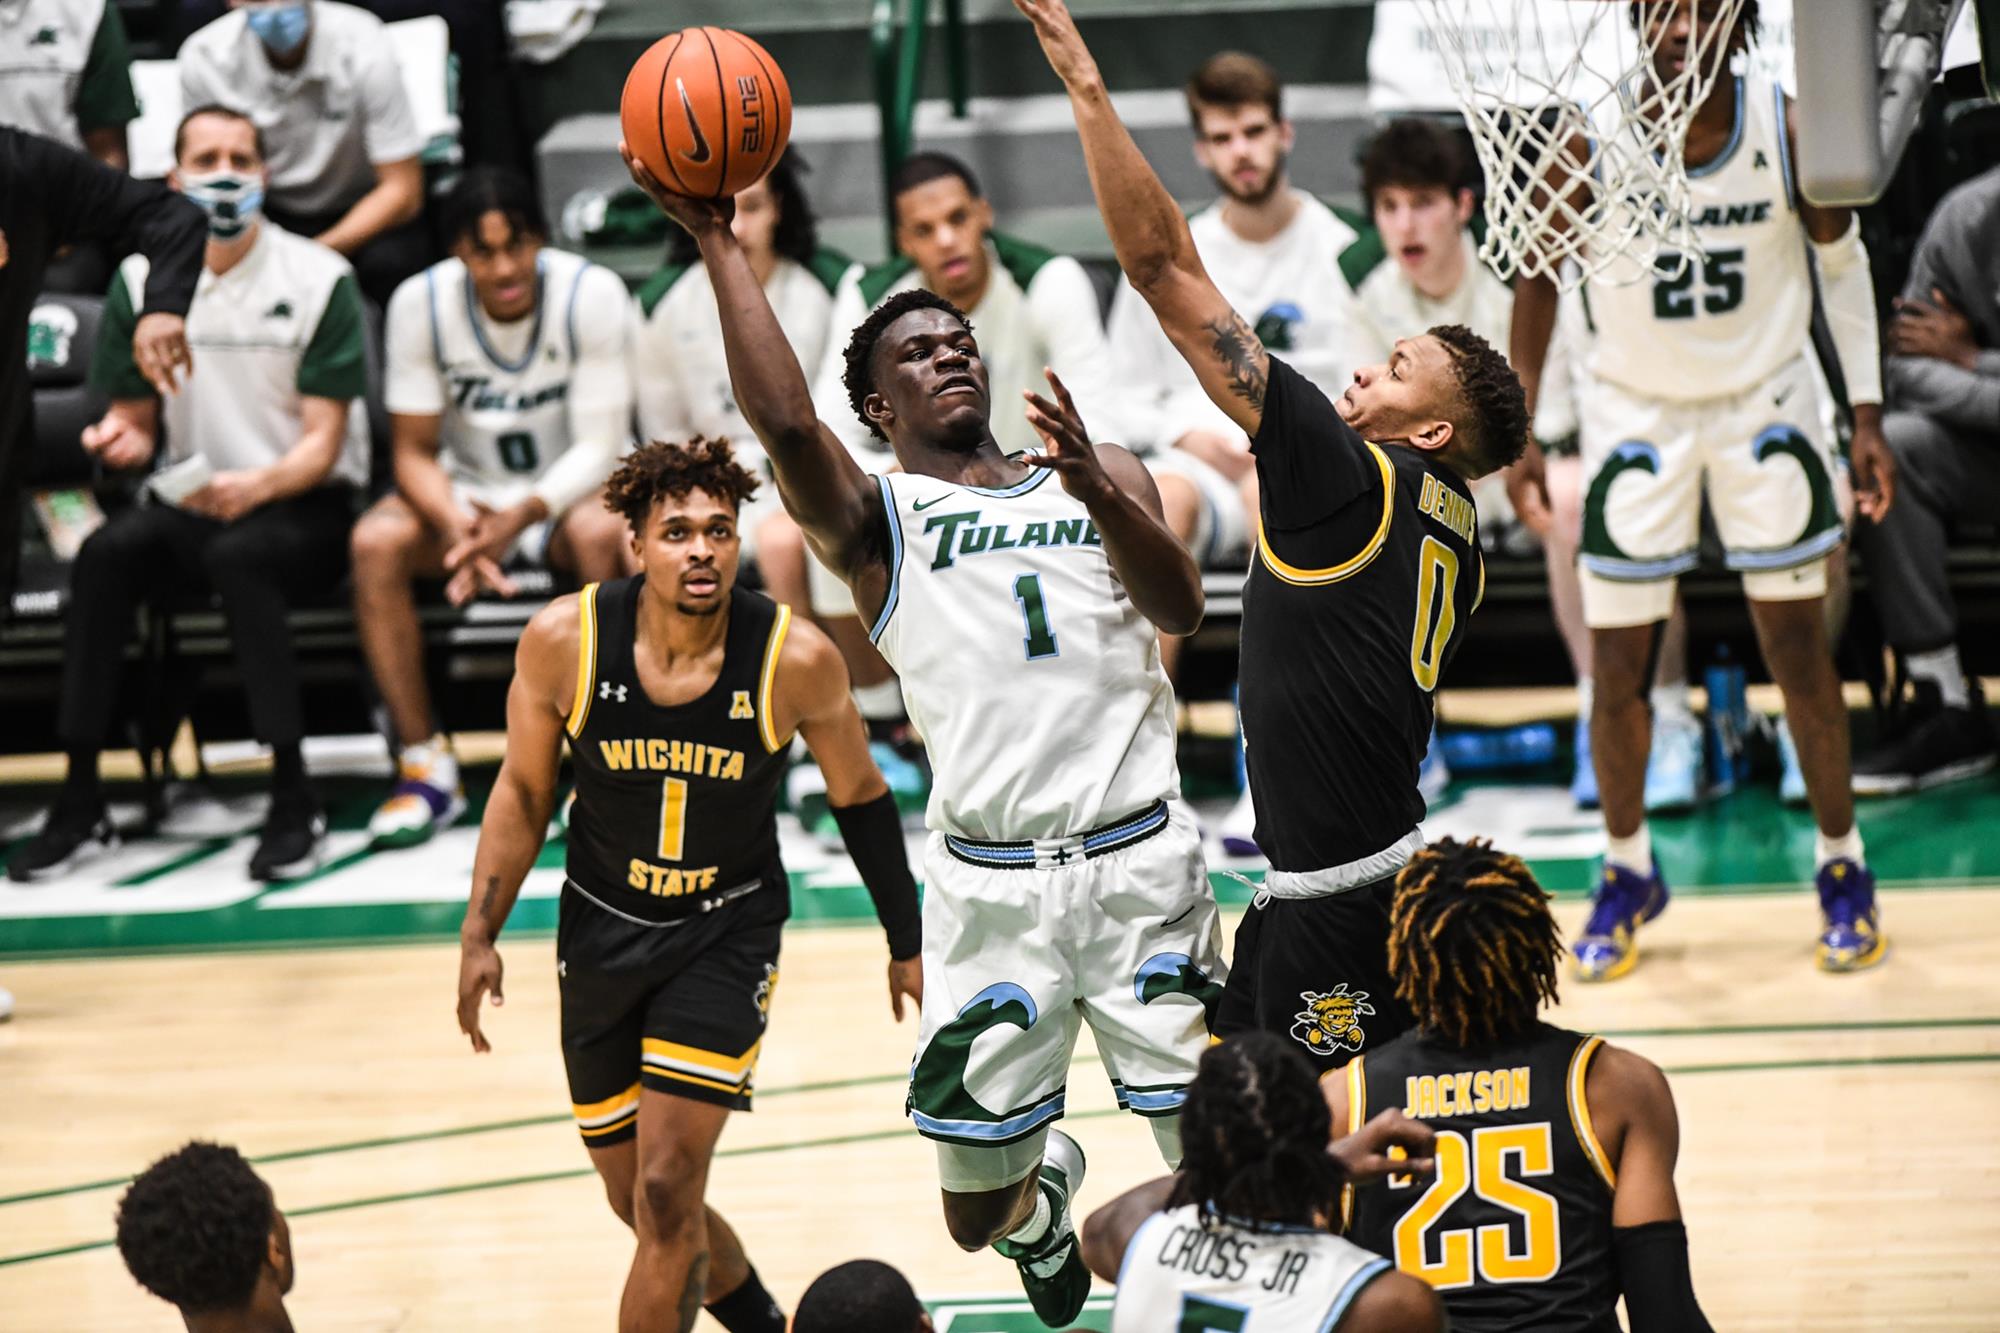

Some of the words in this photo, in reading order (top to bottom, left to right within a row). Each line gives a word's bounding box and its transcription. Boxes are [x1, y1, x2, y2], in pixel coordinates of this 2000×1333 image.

[1653, 249, 1744, 319] 25
[497, 432, 539, 475] 0
[923, 510, 1102, 573] TULANE
[1418, 471, 1476, 546] DENNIS
[1012, 571, 1060, 661] 1
[1411, 534, 1459, 693] 0
[729, 690, 755, 720] A
[599, 739, 745, 780] WICHITA
[657, 776, 688, 862] 1
[627, 857, 719, 897] STATE
[1401, 1066, 1531, 1119] JACKSON
[1387, 1121, 1562, 1291] 25
[1158, 1225, 1257, 1282] CROSS
[1261, 1249, 1309, 1294] JR
